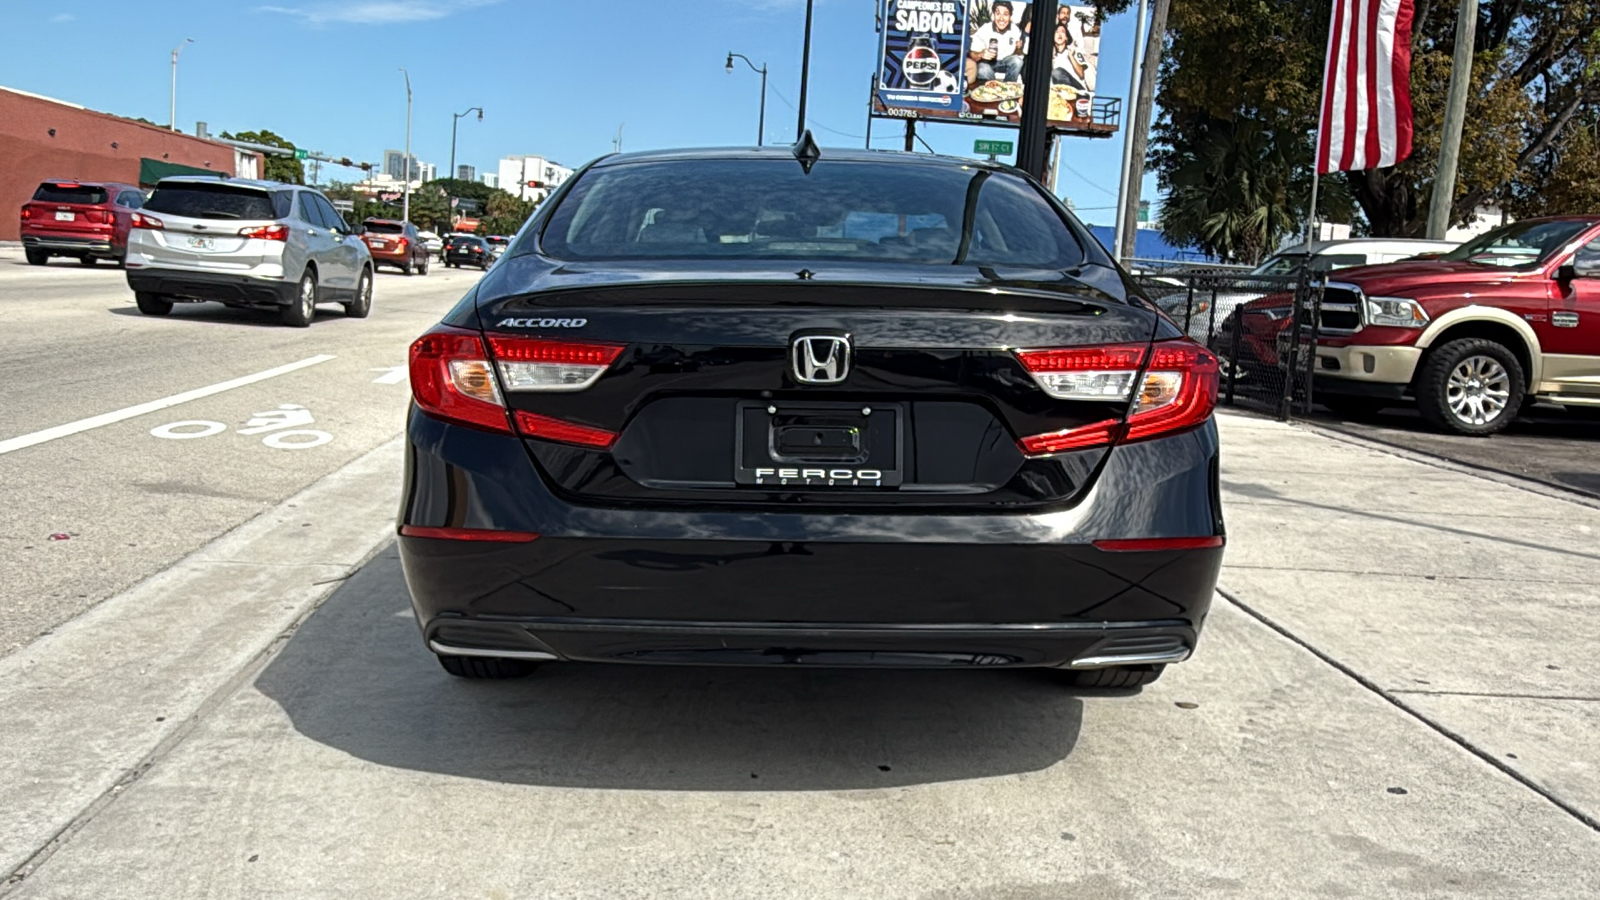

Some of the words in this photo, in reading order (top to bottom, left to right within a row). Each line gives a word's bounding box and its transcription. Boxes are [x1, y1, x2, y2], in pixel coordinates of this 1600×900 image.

[896, 0, 942, 11] CAMPEONES
[942, 2, 956, 12] DEL
[895, 9, 955, 34] SABOR
[906, 61, 938, 70] PEPSI
[887, 108, 918, 118] 003785
[978, 142, 990, 151] SW
[496, 317, 587, 328] ACCORD
[756, 468, 882, 479] FERCO
[756, 478, 882, 487] MOTORS
